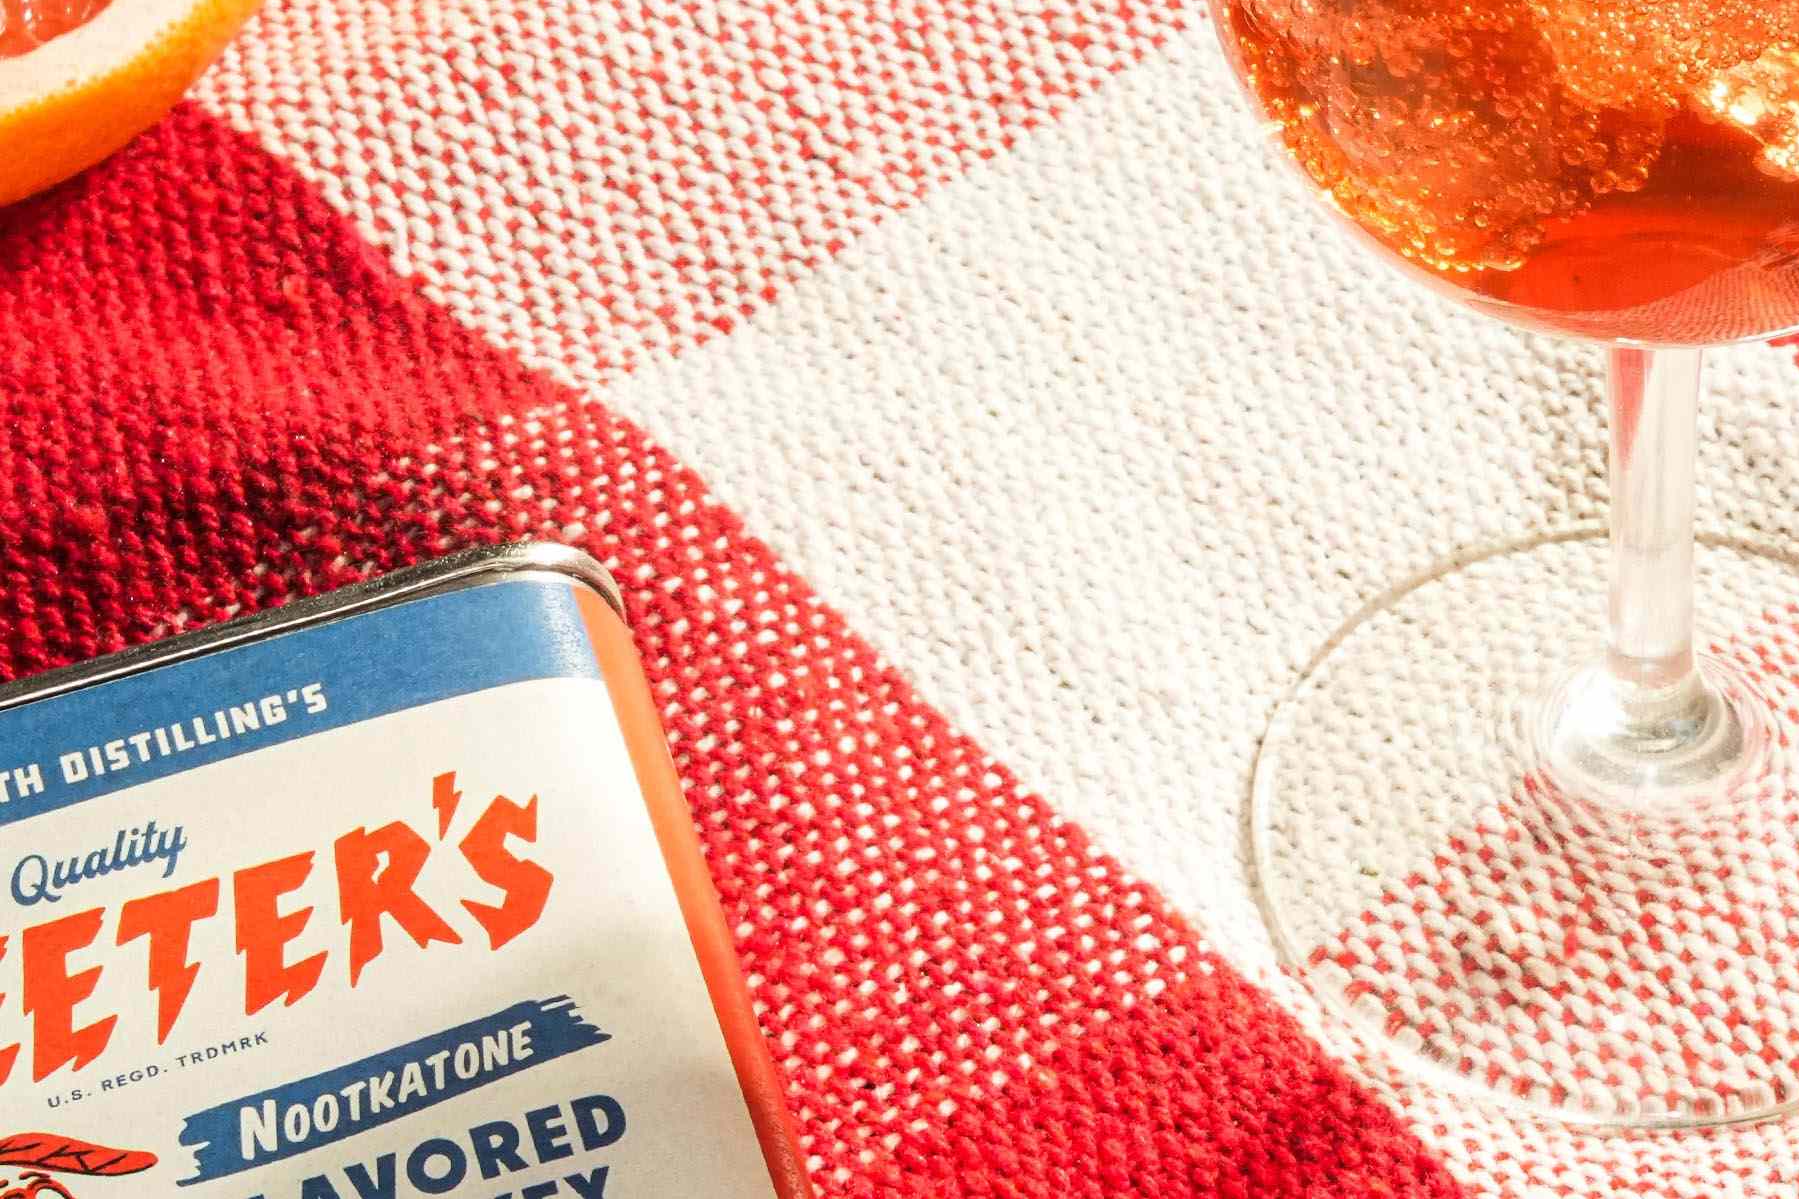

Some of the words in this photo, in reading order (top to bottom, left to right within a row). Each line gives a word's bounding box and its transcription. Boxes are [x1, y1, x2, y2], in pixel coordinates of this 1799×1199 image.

[59, 681, 328, 785] DISTILLING'S
[10, 817, 188, 906] Quality
[0, 771, 554, 1087] ETER'S
[46, 1088, 93, 1109] U.S.
[101, 1064, 169, 1091] REGD.
[176, 1031, 269, 1067] TRDMRK
[239, 1020, 535, 1161] NOOTKATONE
[246, 1093, 628, 1199] VORED
